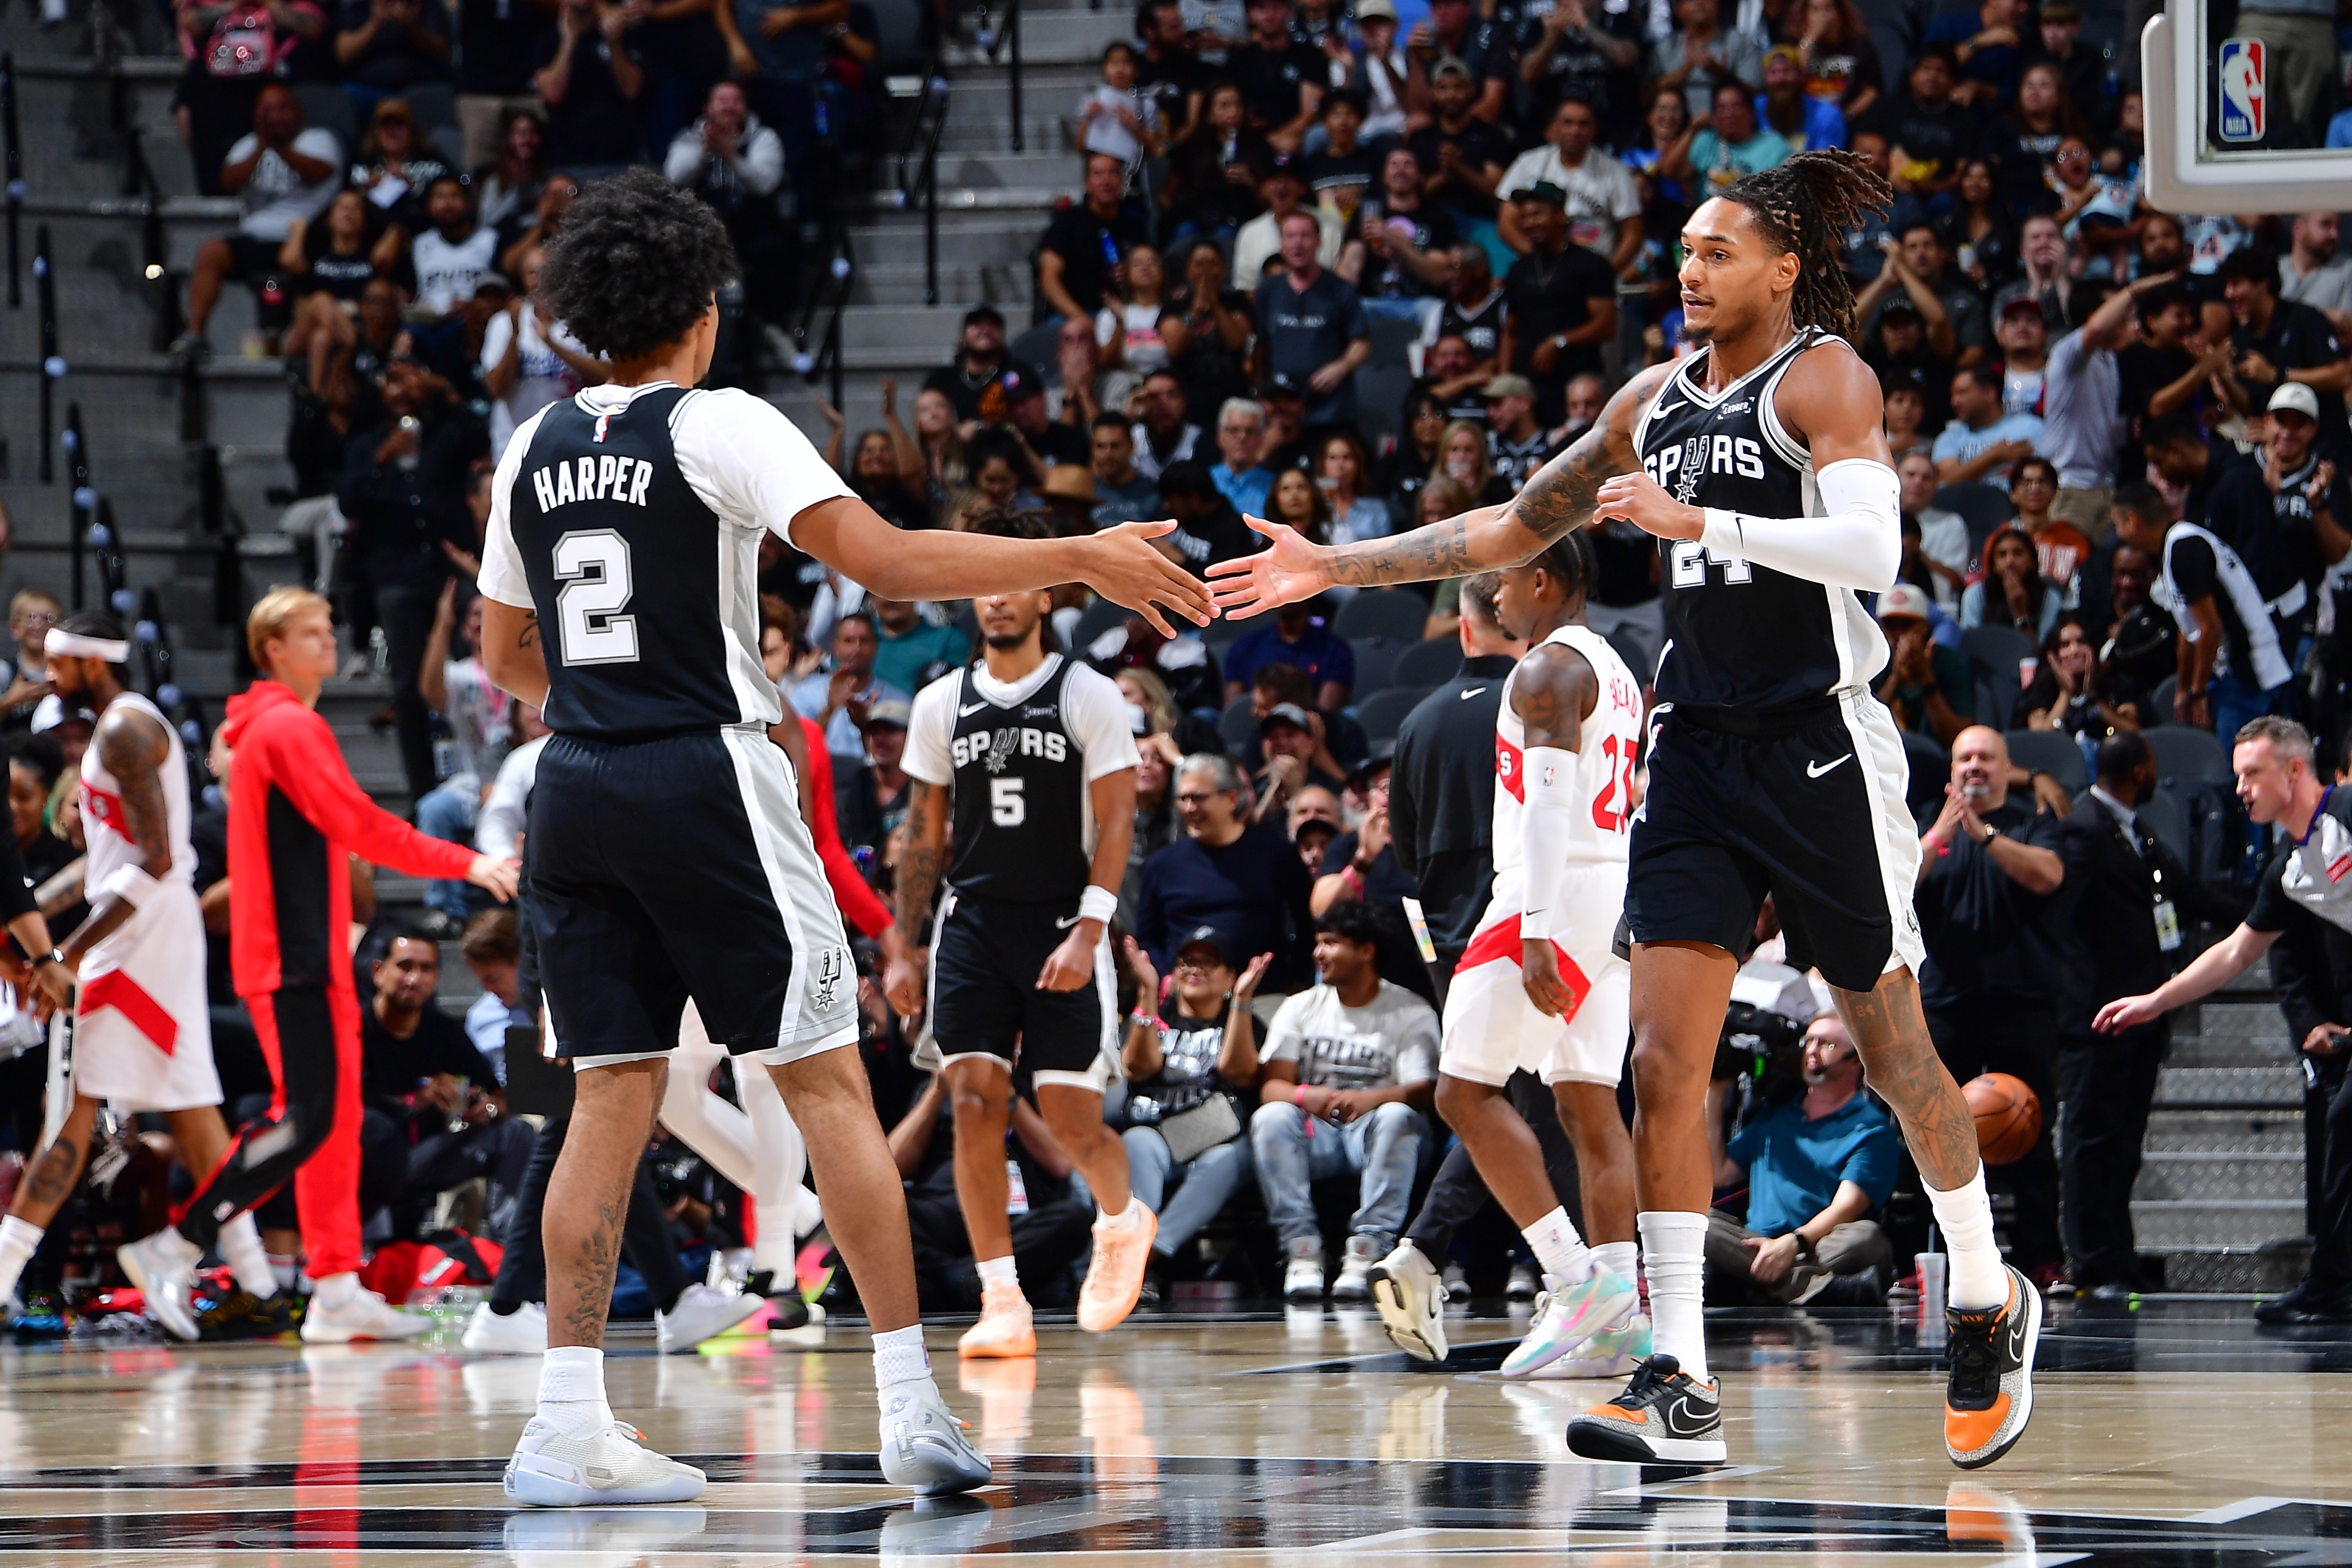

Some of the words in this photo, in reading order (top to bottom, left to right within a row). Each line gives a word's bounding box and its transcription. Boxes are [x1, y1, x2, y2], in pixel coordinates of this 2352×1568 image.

[2225, 116, 2248, 135] NBA
[1723, 401, 1749, 415] LEDGER
[533, 455, 653, 514] HARPER
[1644, 434, 1765, 504] SPURS
[551, 527, 640, 667] 2
[951, 726, 1067, 774] SPURS
[990, 776, 1027, 827] 5
